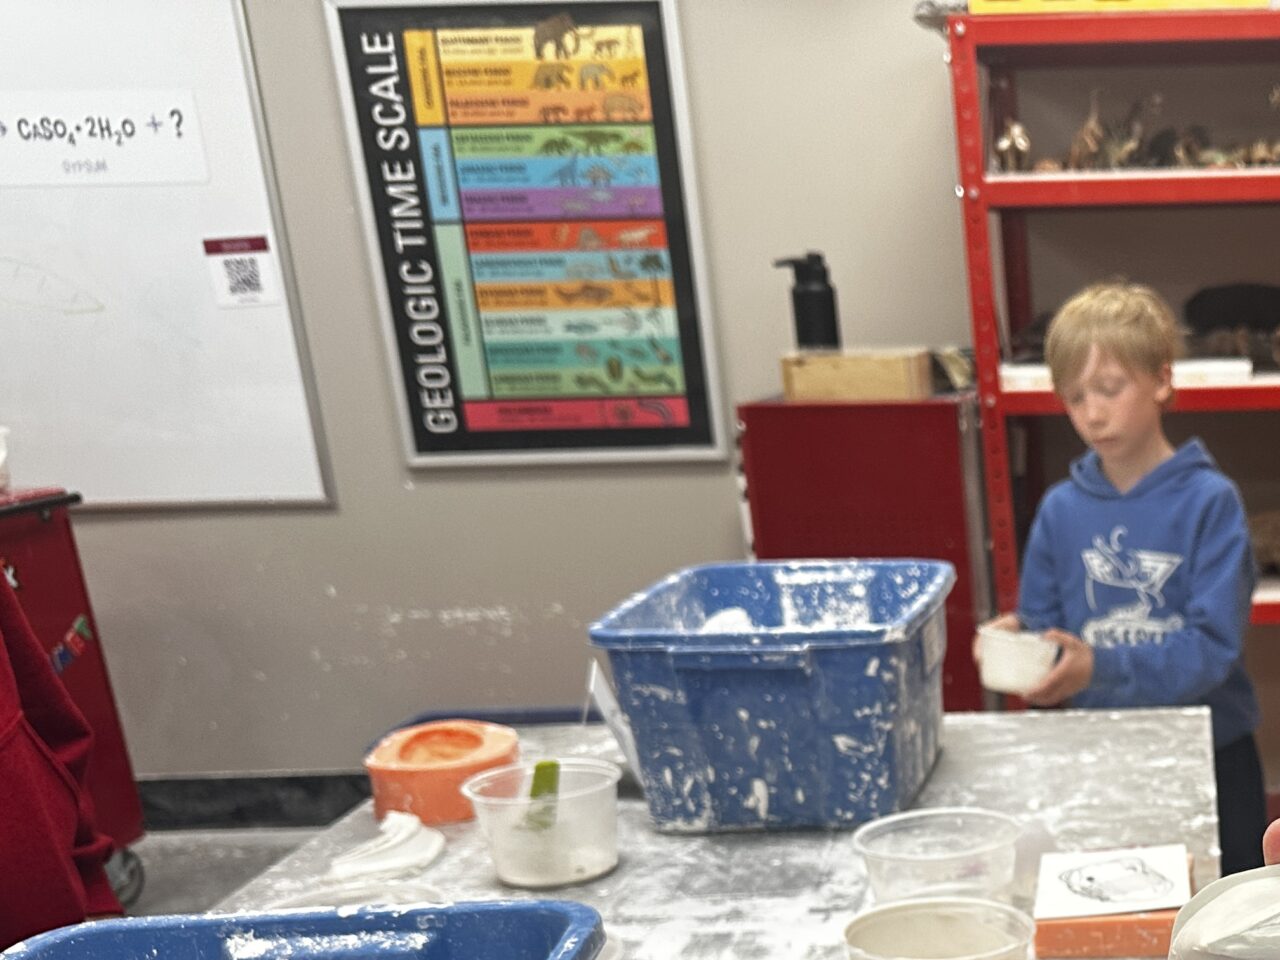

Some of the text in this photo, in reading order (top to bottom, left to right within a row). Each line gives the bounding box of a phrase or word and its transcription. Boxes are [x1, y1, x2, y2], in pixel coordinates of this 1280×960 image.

[169, 108, 183, 138] ?
[360, 31, 459, 434] GEOLOGIC TIME SCALE
